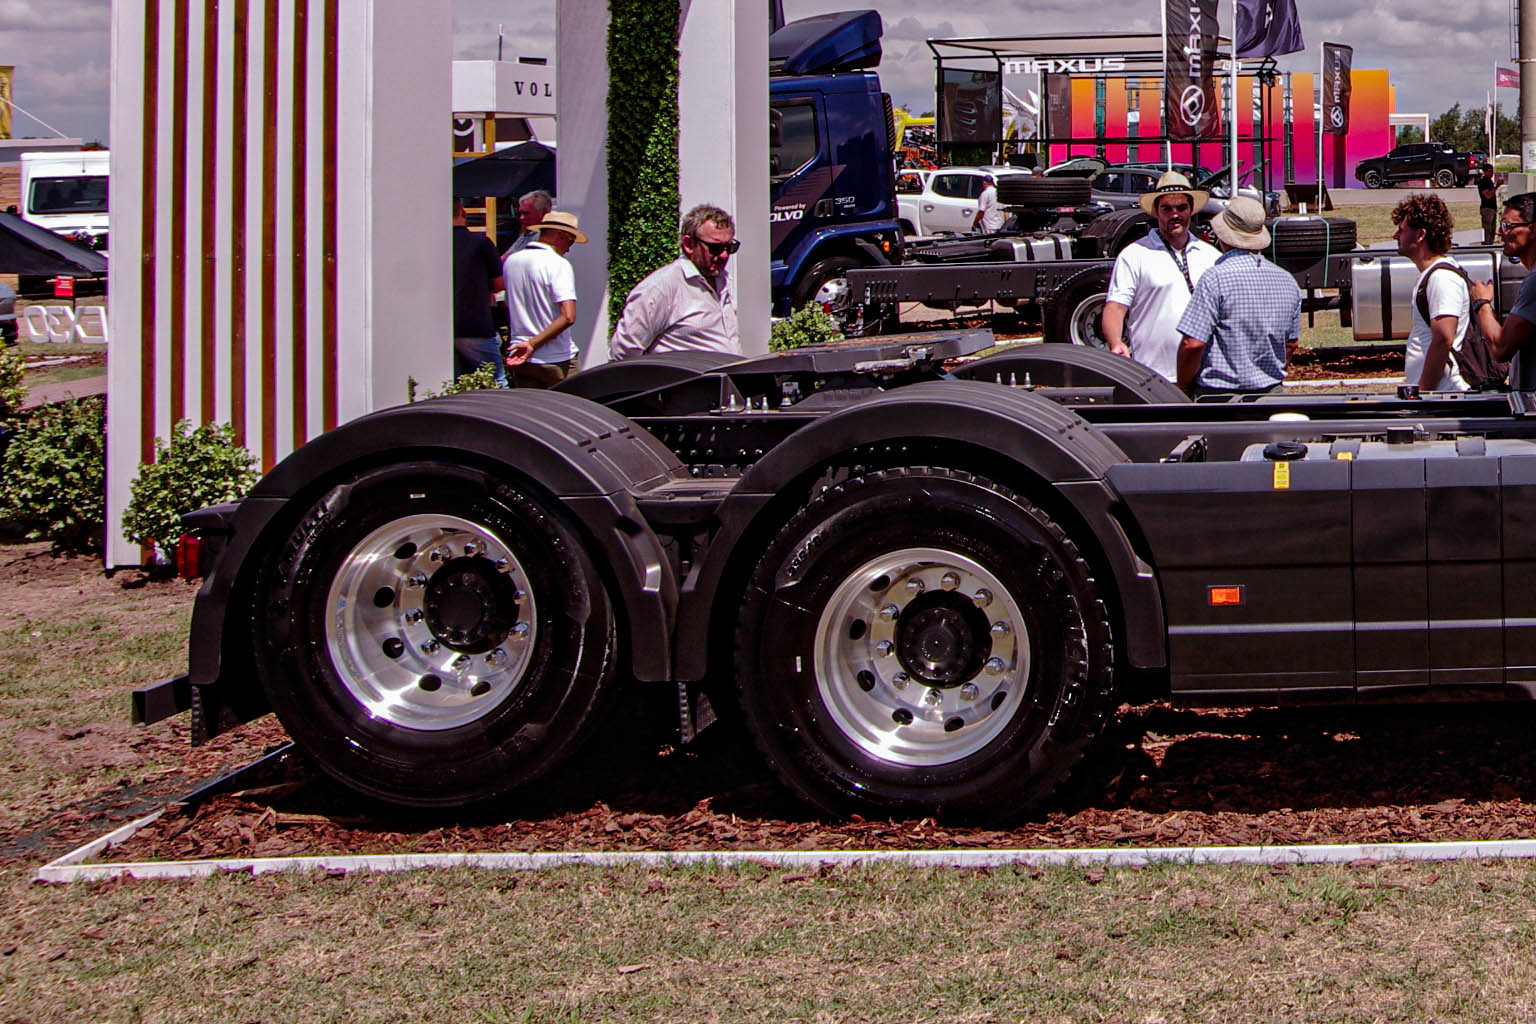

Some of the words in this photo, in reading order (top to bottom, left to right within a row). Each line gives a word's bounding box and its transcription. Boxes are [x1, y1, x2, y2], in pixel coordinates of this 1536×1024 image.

[1004, 57, 1126, 74] MAXUS
[514, 81, 552, 97] VOL
[770, 210, 803, 222] OLVO
